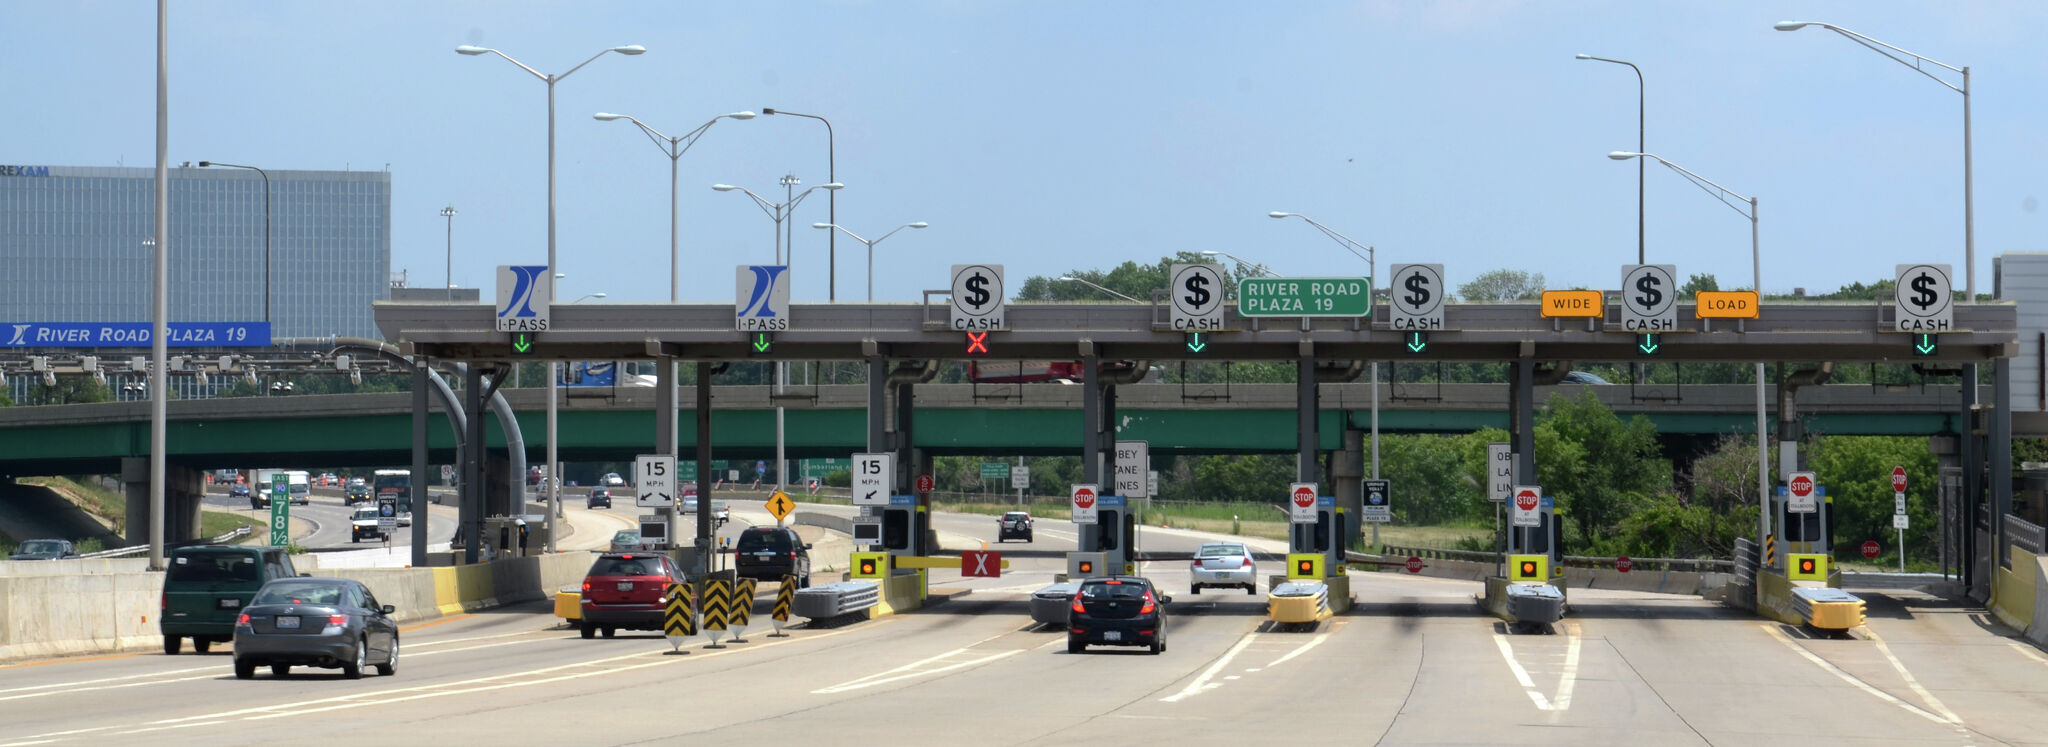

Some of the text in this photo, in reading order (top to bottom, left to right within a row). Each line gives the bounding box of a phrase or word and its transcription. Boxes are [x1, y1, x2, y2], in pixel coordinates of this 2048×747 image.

[0, 165, 49, 177] REXAM
[1248, 283, 1360, 295] RIVER ROAD
[1248, 298, 1333, 311] PLAZA 19
[1553, 299, 1591, 308] WIDE
[1708, 300, 1746, 309] LOAD
[498, 319, 547, 330] I-PASS
[738, 319, 786, 330] I-PASS
[955, 318, 1000, 329] CASH
[1175, 318, 1219, 329] CASH
[1394, 317, 1440, 329] CASH
[1626, 319, 1672, 330] CASH
[1901, 319, 1948, 331] CASH
[225, 327, 246, 341] 19
[1115, 449, 1138, 459] BEY
[1497, 452, 1512, 460] OB
[646, 461, 665, 476] 15
[862, 460, 881, 475] 15
[1497, 468, 1511, 476] LA
[1892, 474, 1907, 485] STOP
[1497, 483, 1512, 492] LIN
[1791, 482, 1812, 491] STOP
[1075, 494, 1094, 503] STOP
[1294, 493, 1314, 502] STOP
[1517, 496, 1537, 505] STOP
[1863, 546, 1879, 554] STOP
[1407, 561, 1423, 569] STOP
